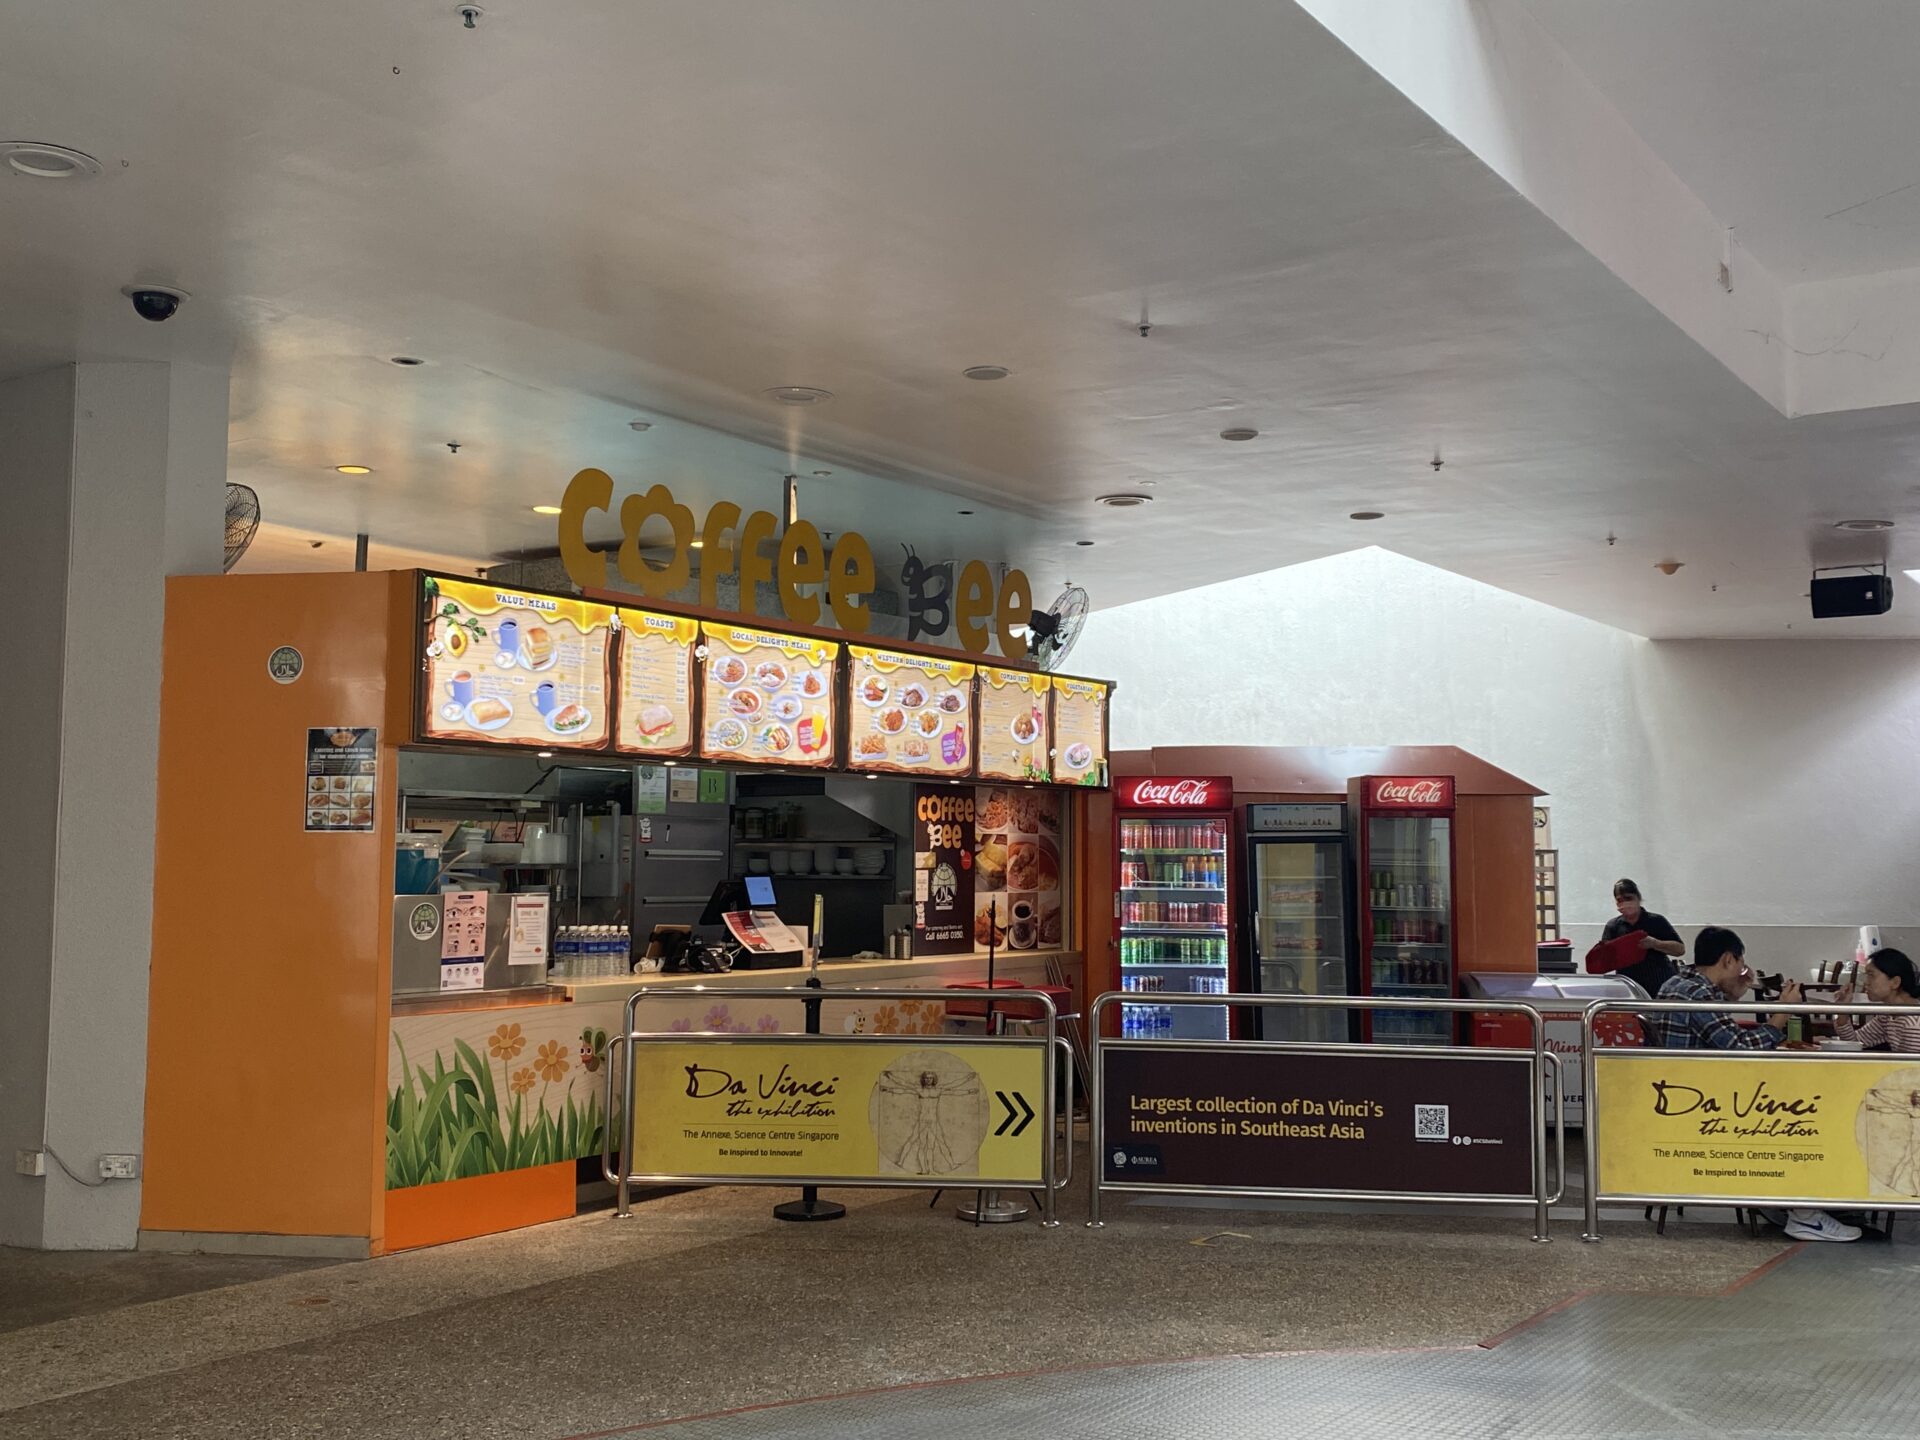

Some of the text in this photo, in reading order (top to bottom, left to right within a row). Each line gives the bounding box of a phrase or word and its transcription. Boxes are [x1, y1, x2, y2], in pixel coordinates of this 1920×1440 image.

[496, 594, 556, 610] VALUE MEALS
[900, 542, 1033, 658] Bee
[645, 617, 674, 628] TOASTS
[731, 631, 811, 650] LOCAL DELIGHTS MEALS
[877, 654, 951, 670] WESTERN DELIGHTS MEALS
[1133, 779, 1211, 804] Coca-Cola
[1376, 780, 1445, 803] Coca-Cola
[926, 932, 935, 940] Call
[684, 1064, 839, 1099] Da Vinci
[1131, 1095, 1192, 1115] Largest
[1196, 1097, 1277, 1114] collection
[1281, 1099, 1300, 1114] of
[1303, 1100, 1325, 1116] Da
[1652, 1080, 1821, 1118] Da Vinci
[726, 1100, 836, 1119] the exhibition
[683, 1130, 839, 1142] The Annexe, Science Centre Singapore
[1131, 1116, 1365, 1139] inventions in Southeast Asia
[1699, 1118, 1819, 1139] the exhibition
[730, 1149, 759, 1157] Inspired
[1653, 1148, 1824, 1162] The Annexe, Science Centre Singapore
[1705, 1168, 1737, 1177] Inspired
[1749, 1170, 1785, 1178] Innovate!
